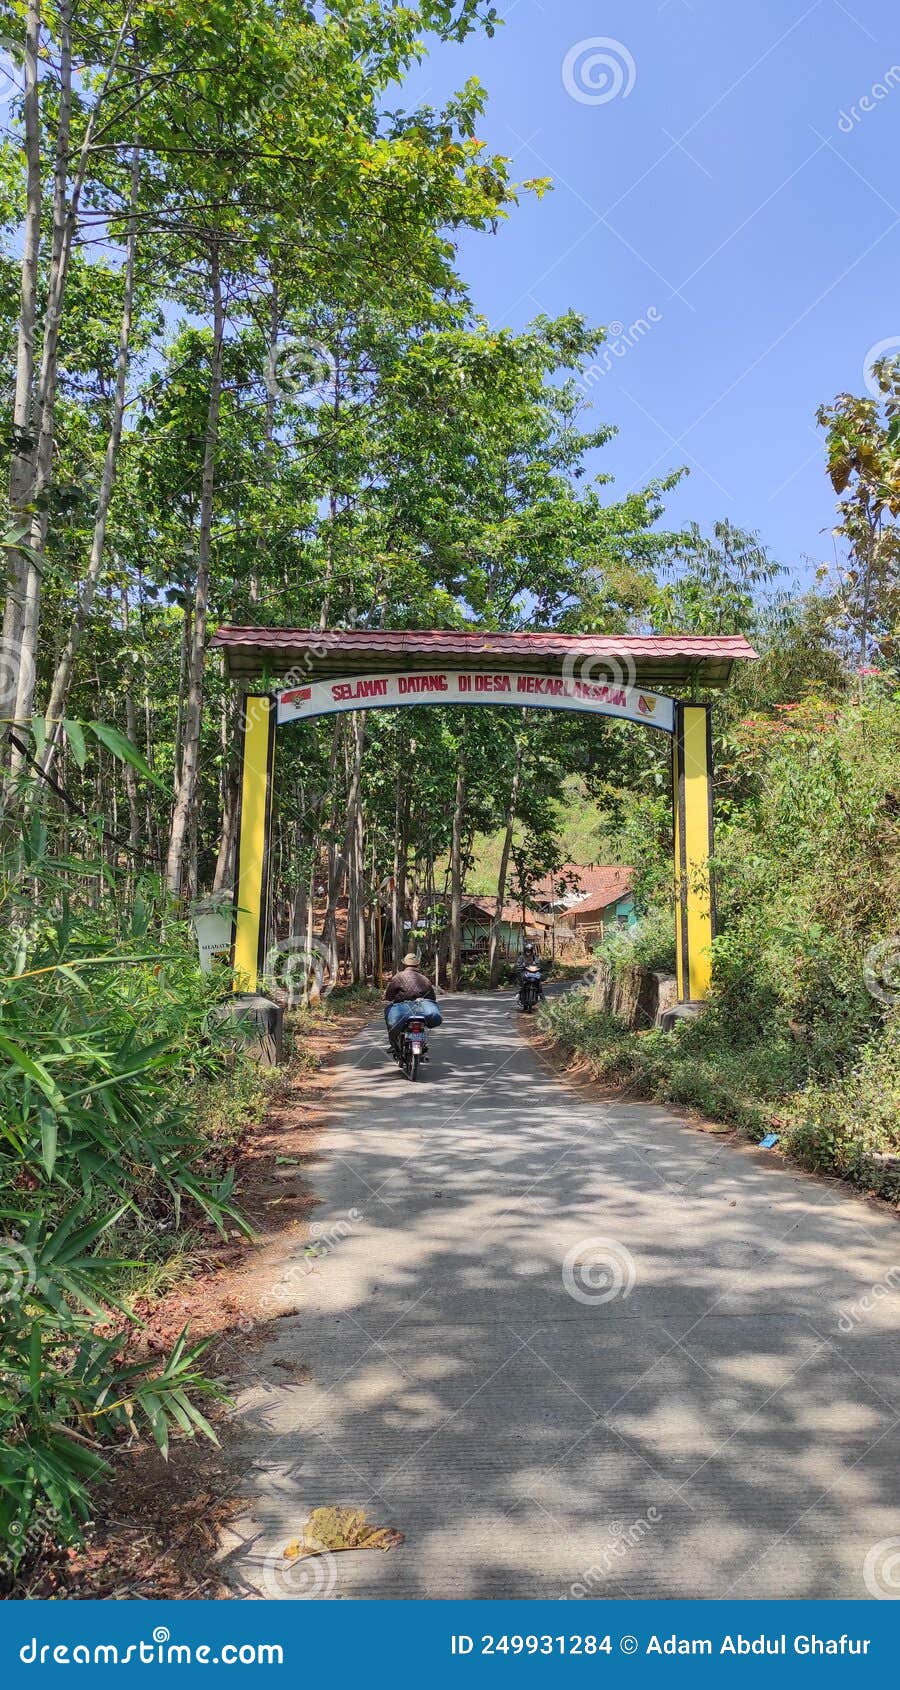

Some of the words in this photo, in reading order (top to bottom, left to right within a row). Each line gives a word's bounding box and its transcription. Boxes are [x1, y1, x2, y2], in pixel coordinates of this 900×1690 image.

[331, 679, 388, 701] SELAMAT
[398, 675, 448, 694] DATANG
[458, 675, 472, 692] DI
[475, 675, 512, 692] DESA
